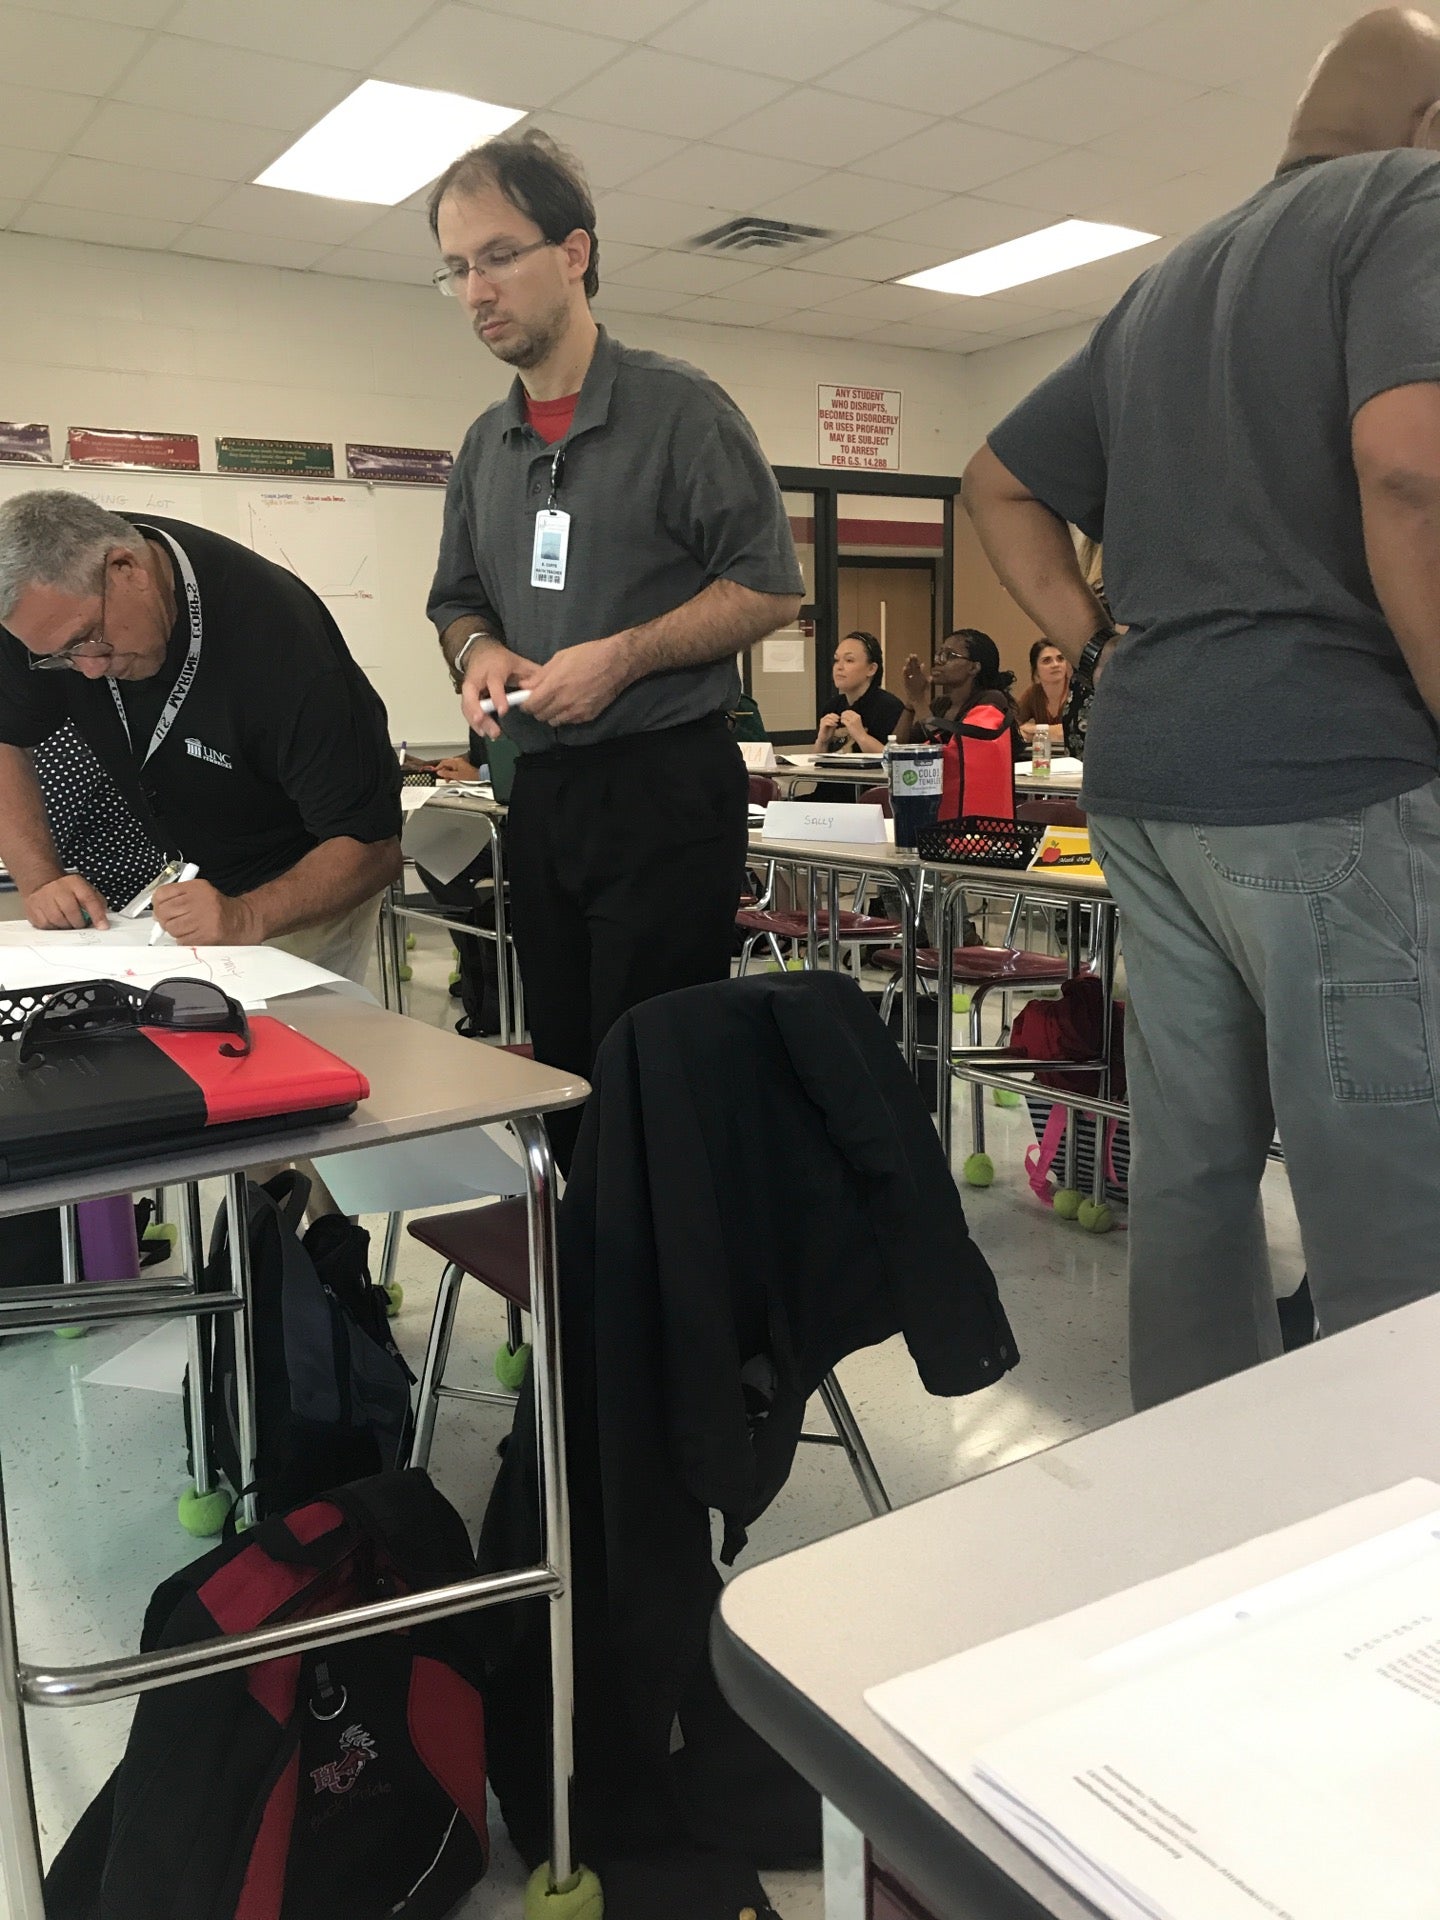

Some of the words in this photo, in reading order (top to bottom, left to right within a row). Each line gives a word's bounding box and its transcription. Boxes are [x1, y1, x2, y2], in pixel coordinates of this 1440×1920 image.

[835, 388, 851, 398] ANY
[852, 389, 884, 401] STUDENT
[831, 399, 848, 409] WHO
[850, 400, 888, 414] DISRUPTS,
[819, 409, 854, 421] BECOMES
[856, 412, 899, 425] DISORDERLY
[823, 421, 834, 430] OR
[836, 422, 854, 432] USES
[856, 424, 895, 436] PROFANITY
[829, 432, 845, 443] MAY
[847, 434, 857, 443] BE
[858, 435, 889, 446] SUBJECT
[840, 445, 850, 454] TO
[851, 446, 879, 456] ARREST
[831, 455, 846, 465] PER
[848, 456, 862, 466] G.S.
[201, 746, 232, 764] UNC
